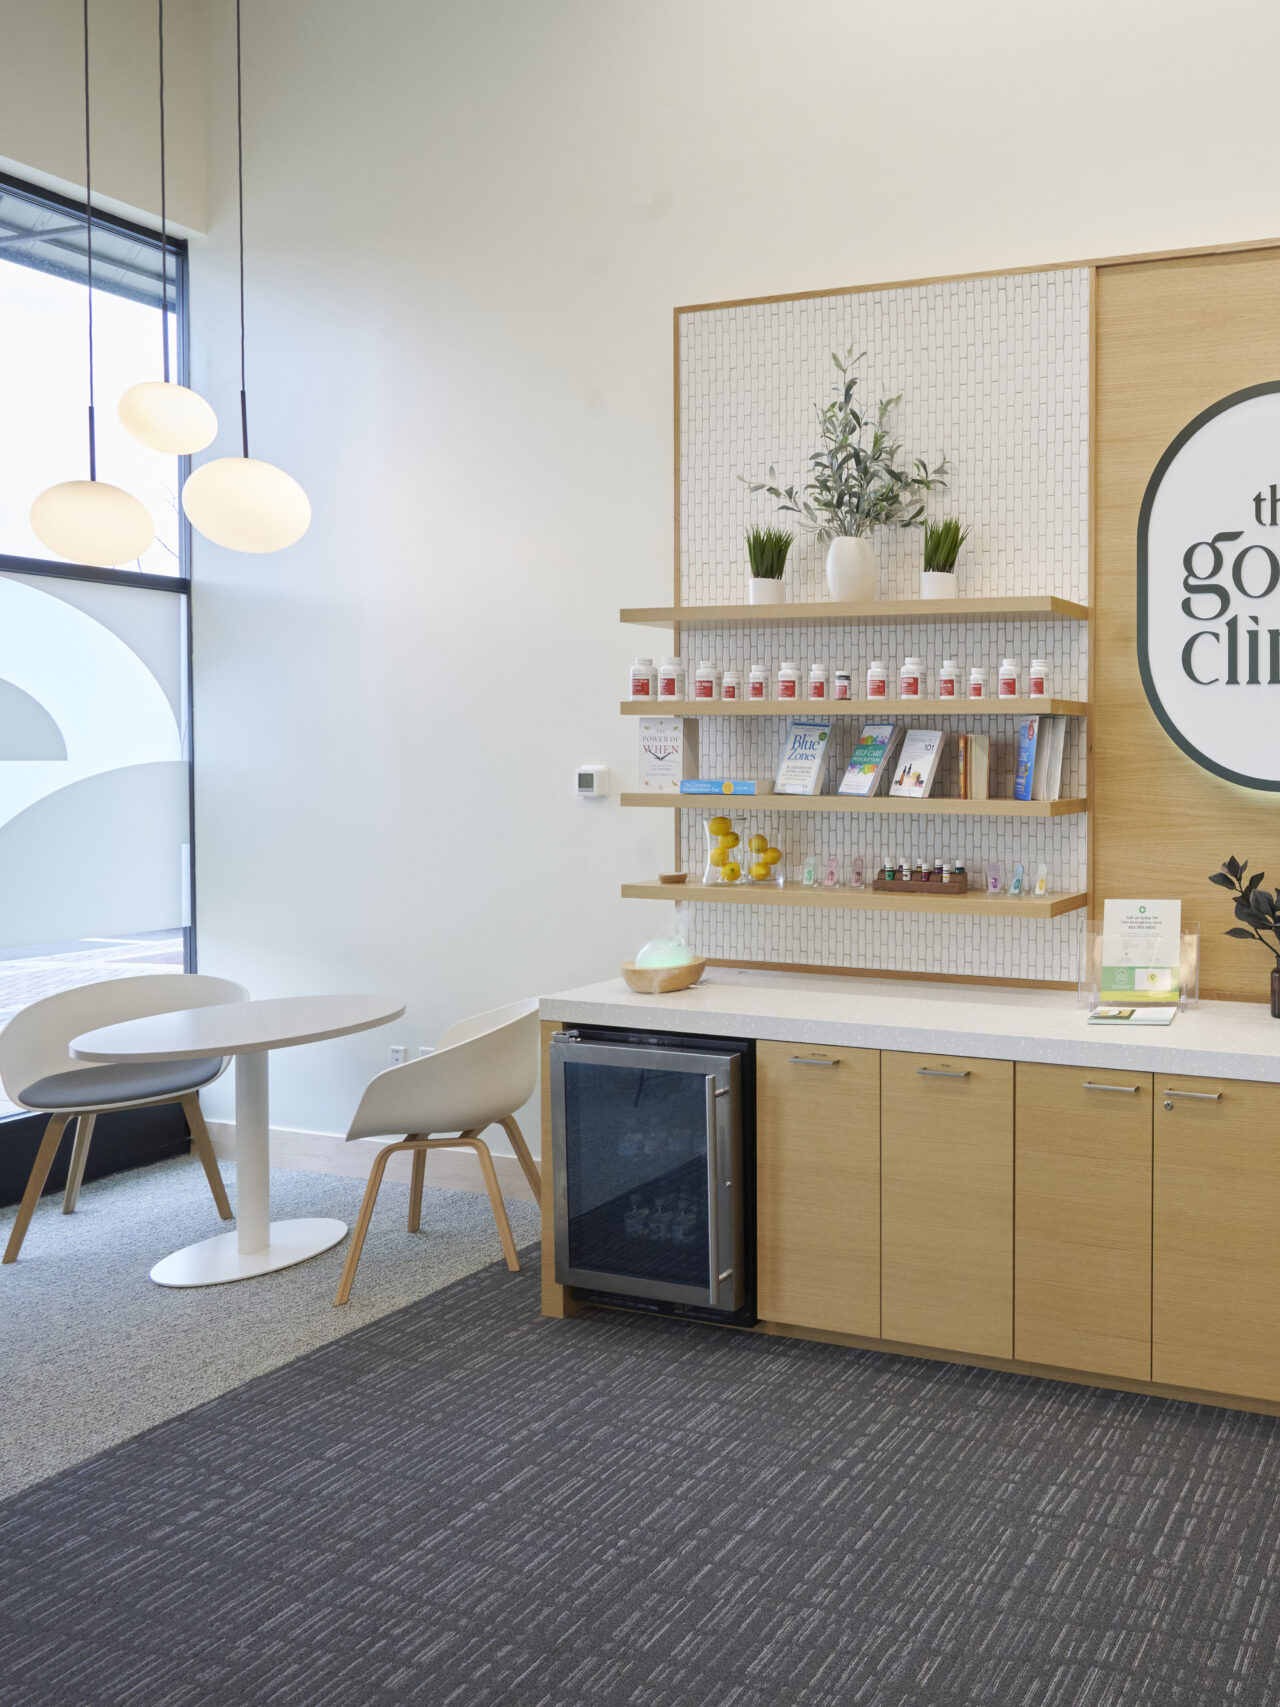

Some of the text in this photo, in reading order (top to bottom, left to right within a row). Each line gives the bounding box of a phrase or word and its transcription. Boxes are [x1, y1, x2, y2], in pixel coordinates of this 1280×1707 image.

[791, 733, 821, 751] Blue
[924, 743, 935, 752] 101
[643, 744, 679, 754] WHEN
[787, 749, 817, 761] Zones
